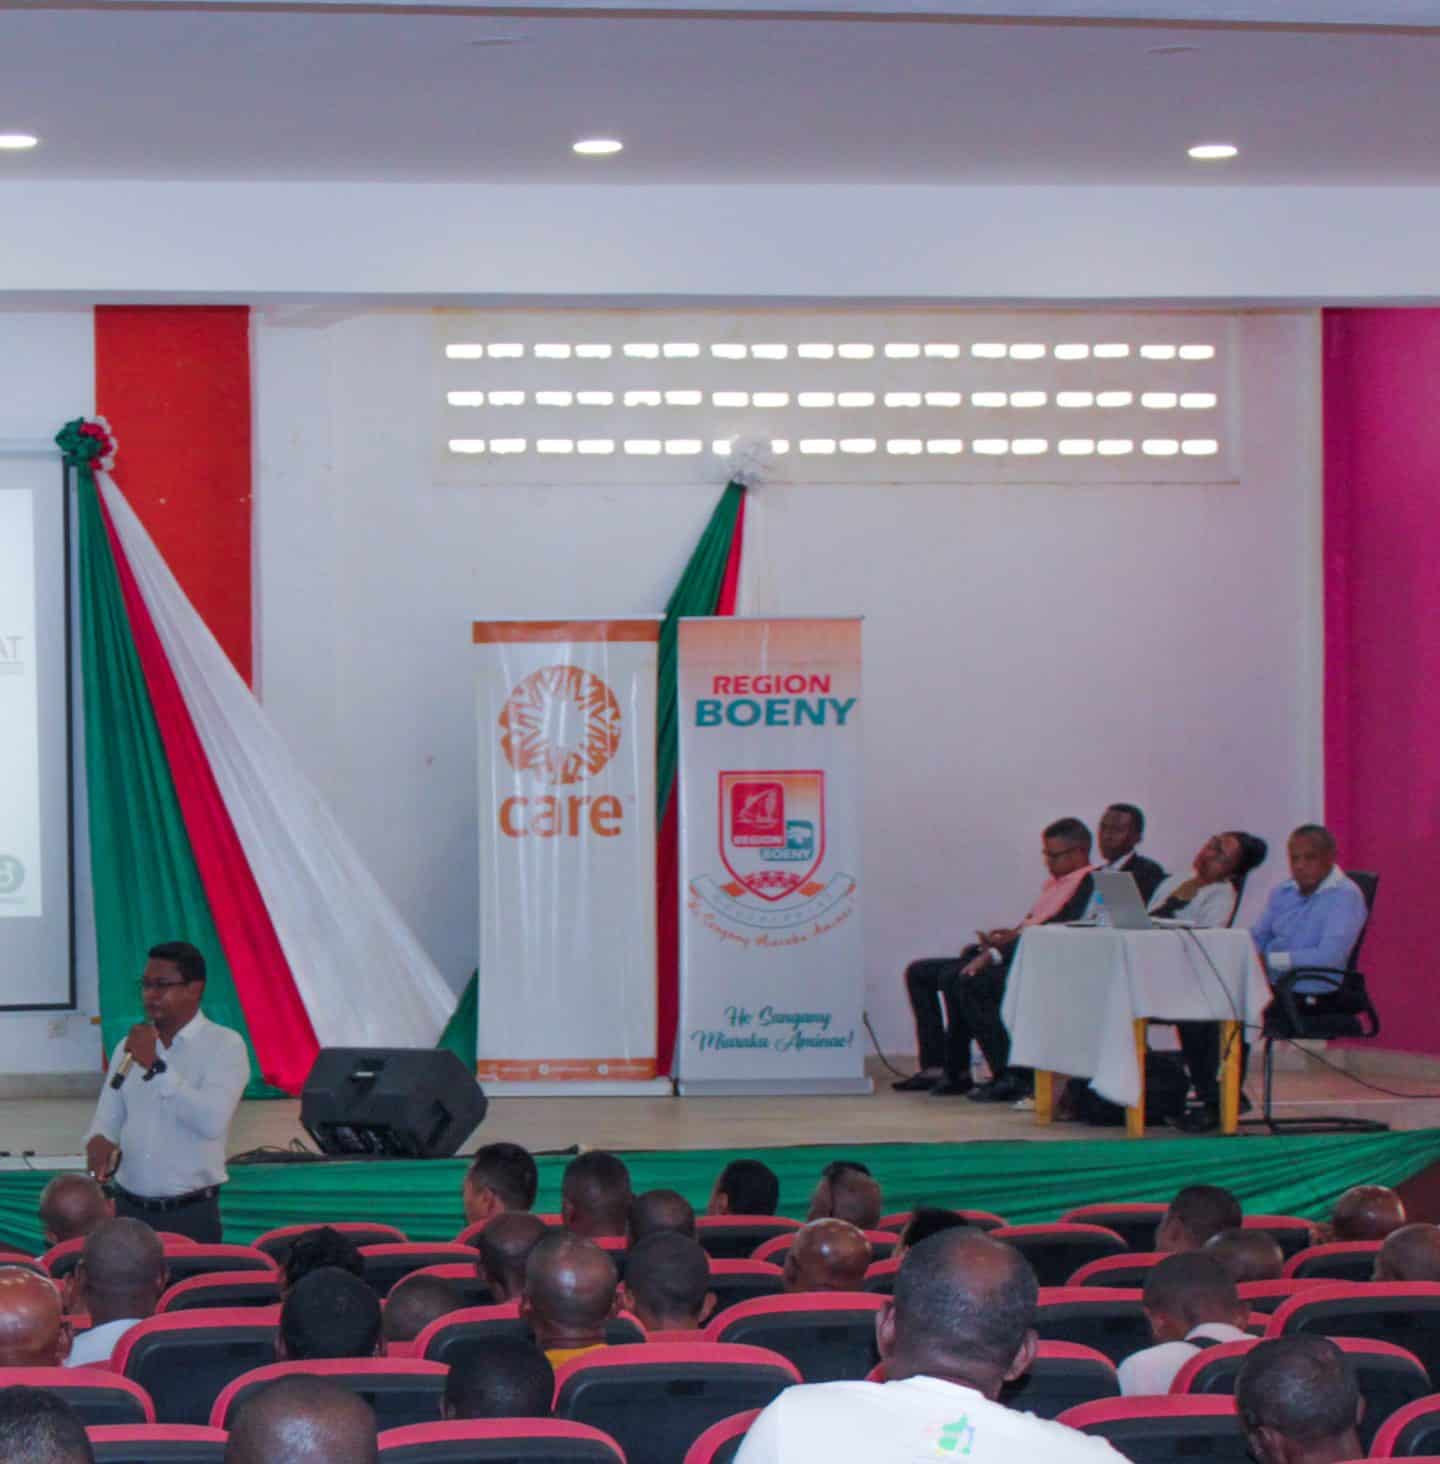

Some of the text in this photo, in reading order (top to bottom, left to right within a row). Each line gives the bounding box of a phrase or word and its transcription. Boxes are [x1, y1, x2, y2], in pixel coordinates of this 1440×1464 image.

[712, 674, 831, 695] REGION
[695, 697, 858, 727] BOENY
[498, 793, 624, 837] care
